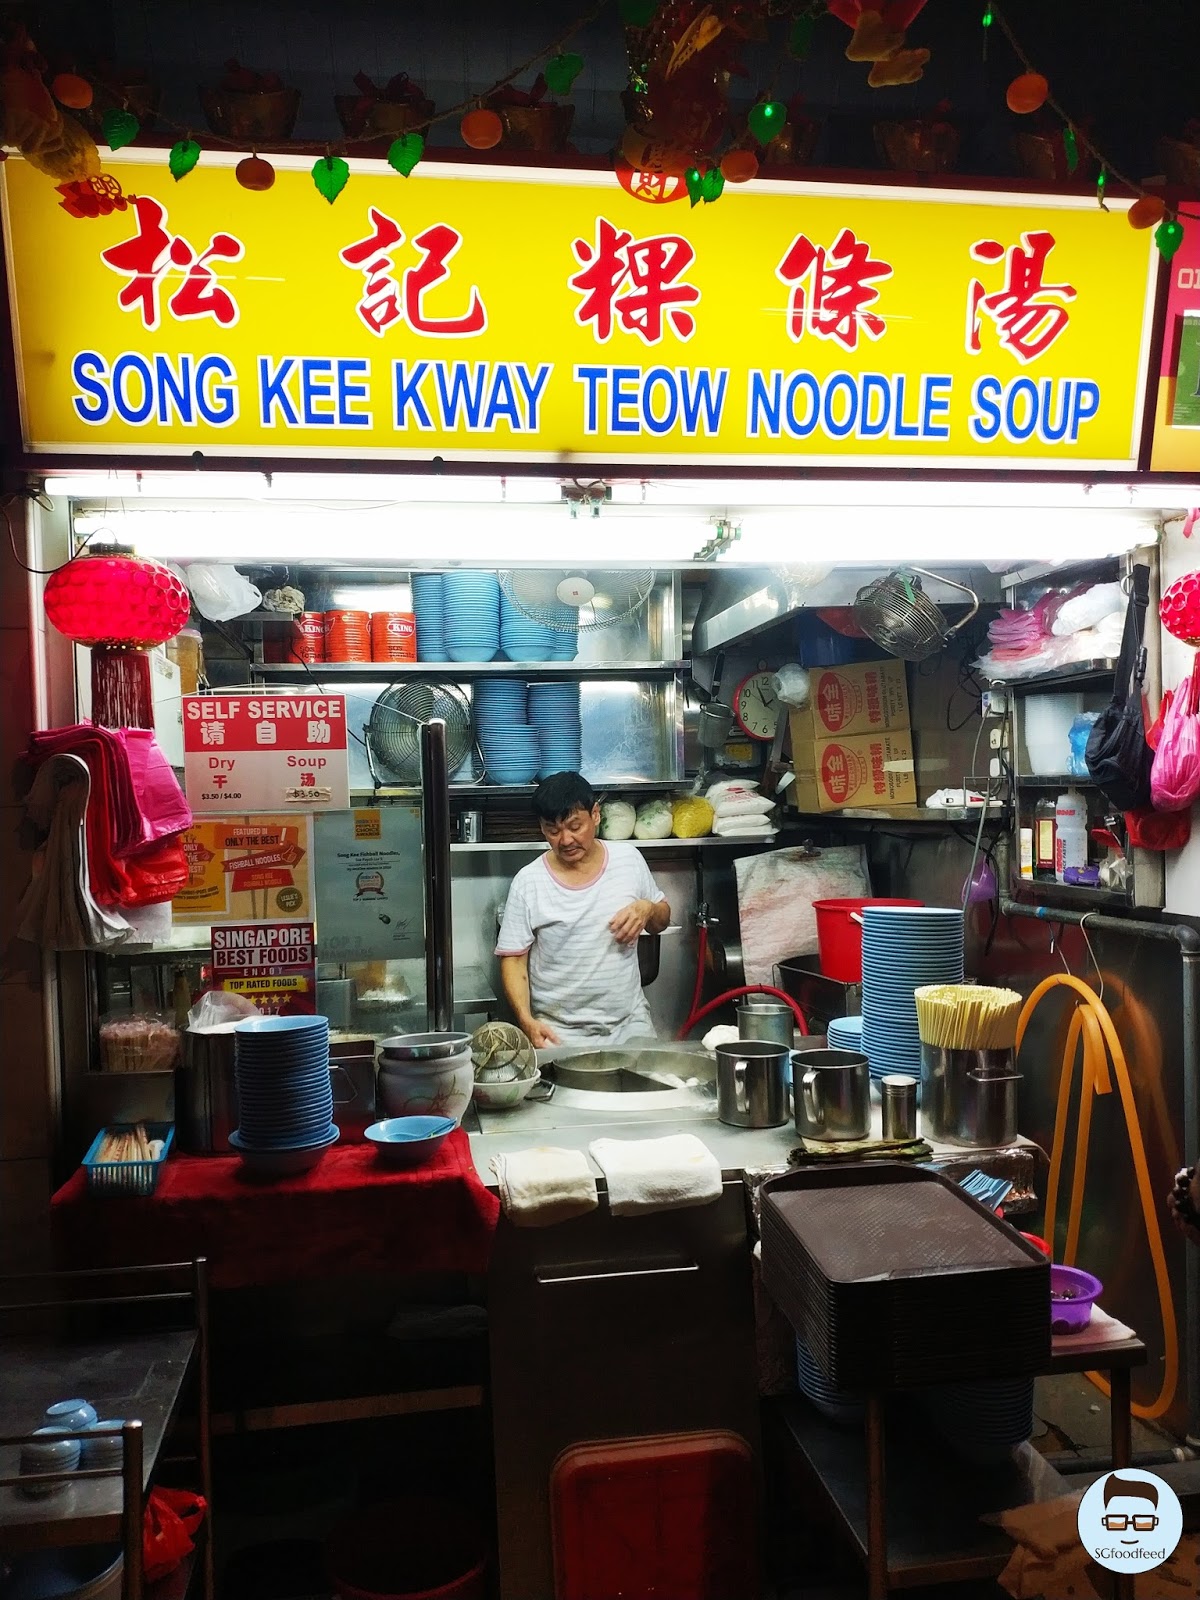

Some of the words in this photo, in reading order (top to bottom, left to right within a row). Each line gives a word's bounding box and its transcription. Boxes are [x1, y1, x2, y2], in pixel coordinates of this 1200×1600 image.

[72, 351, 237, 427] SONG
[259, 355, 373, 431] KEE
[393, 359, 553, 434] KWAY
[573, 364, 728, 438] TEOW
[746, 369, 954, 441] NOODLE
[967, 375, 1100, 446] SOUP
[761, 677, 769, 686] 12
[743, 688, 751, 698] 10
[741, 701, 747, 710] 9
[822, 683, 842, 722] 味全
[187, 701, 240, 720] SELF
[248, 700, 342, 718] SERVICE
[742, 712, 748, 721] 8
[752, 722, 758, 731] 7
[762, 725, 768, 734] 6
[200, 720, 331, 746] 请自助
[208, 757, 235, 771] Dry
[287, 755, 327, 769] Soup
[826, 754, 846, 794] 味全
[213, 775, 228, 789] 干
[300, 773, 316, 787] 汤
[224, 792, 242, 800] $4.00
[293, 789, 320, 798] $3.50
[225, 837, 244, 847] ONLY
[246, 836, 259, 846] THE
[183, 843, 198, 852] ONLY
[229, 859, 254, 870] FISHBALL
[255, 854, 281, 866] NOODLES
[188, 865, 203, 873] EST!
[214, 928, 310, 949] SINGAPORE
[216, 949, 254, 966] BEST
[259, 947, 308, 965] FOODS
[243, 967, 283, 977] ENJOY
[229, 981, 244, 989] TOP
[246, 980, 270, 988] RATED
[272, 978, 298, 987] FOODS
[259, 1007, 280, 1015] 017
